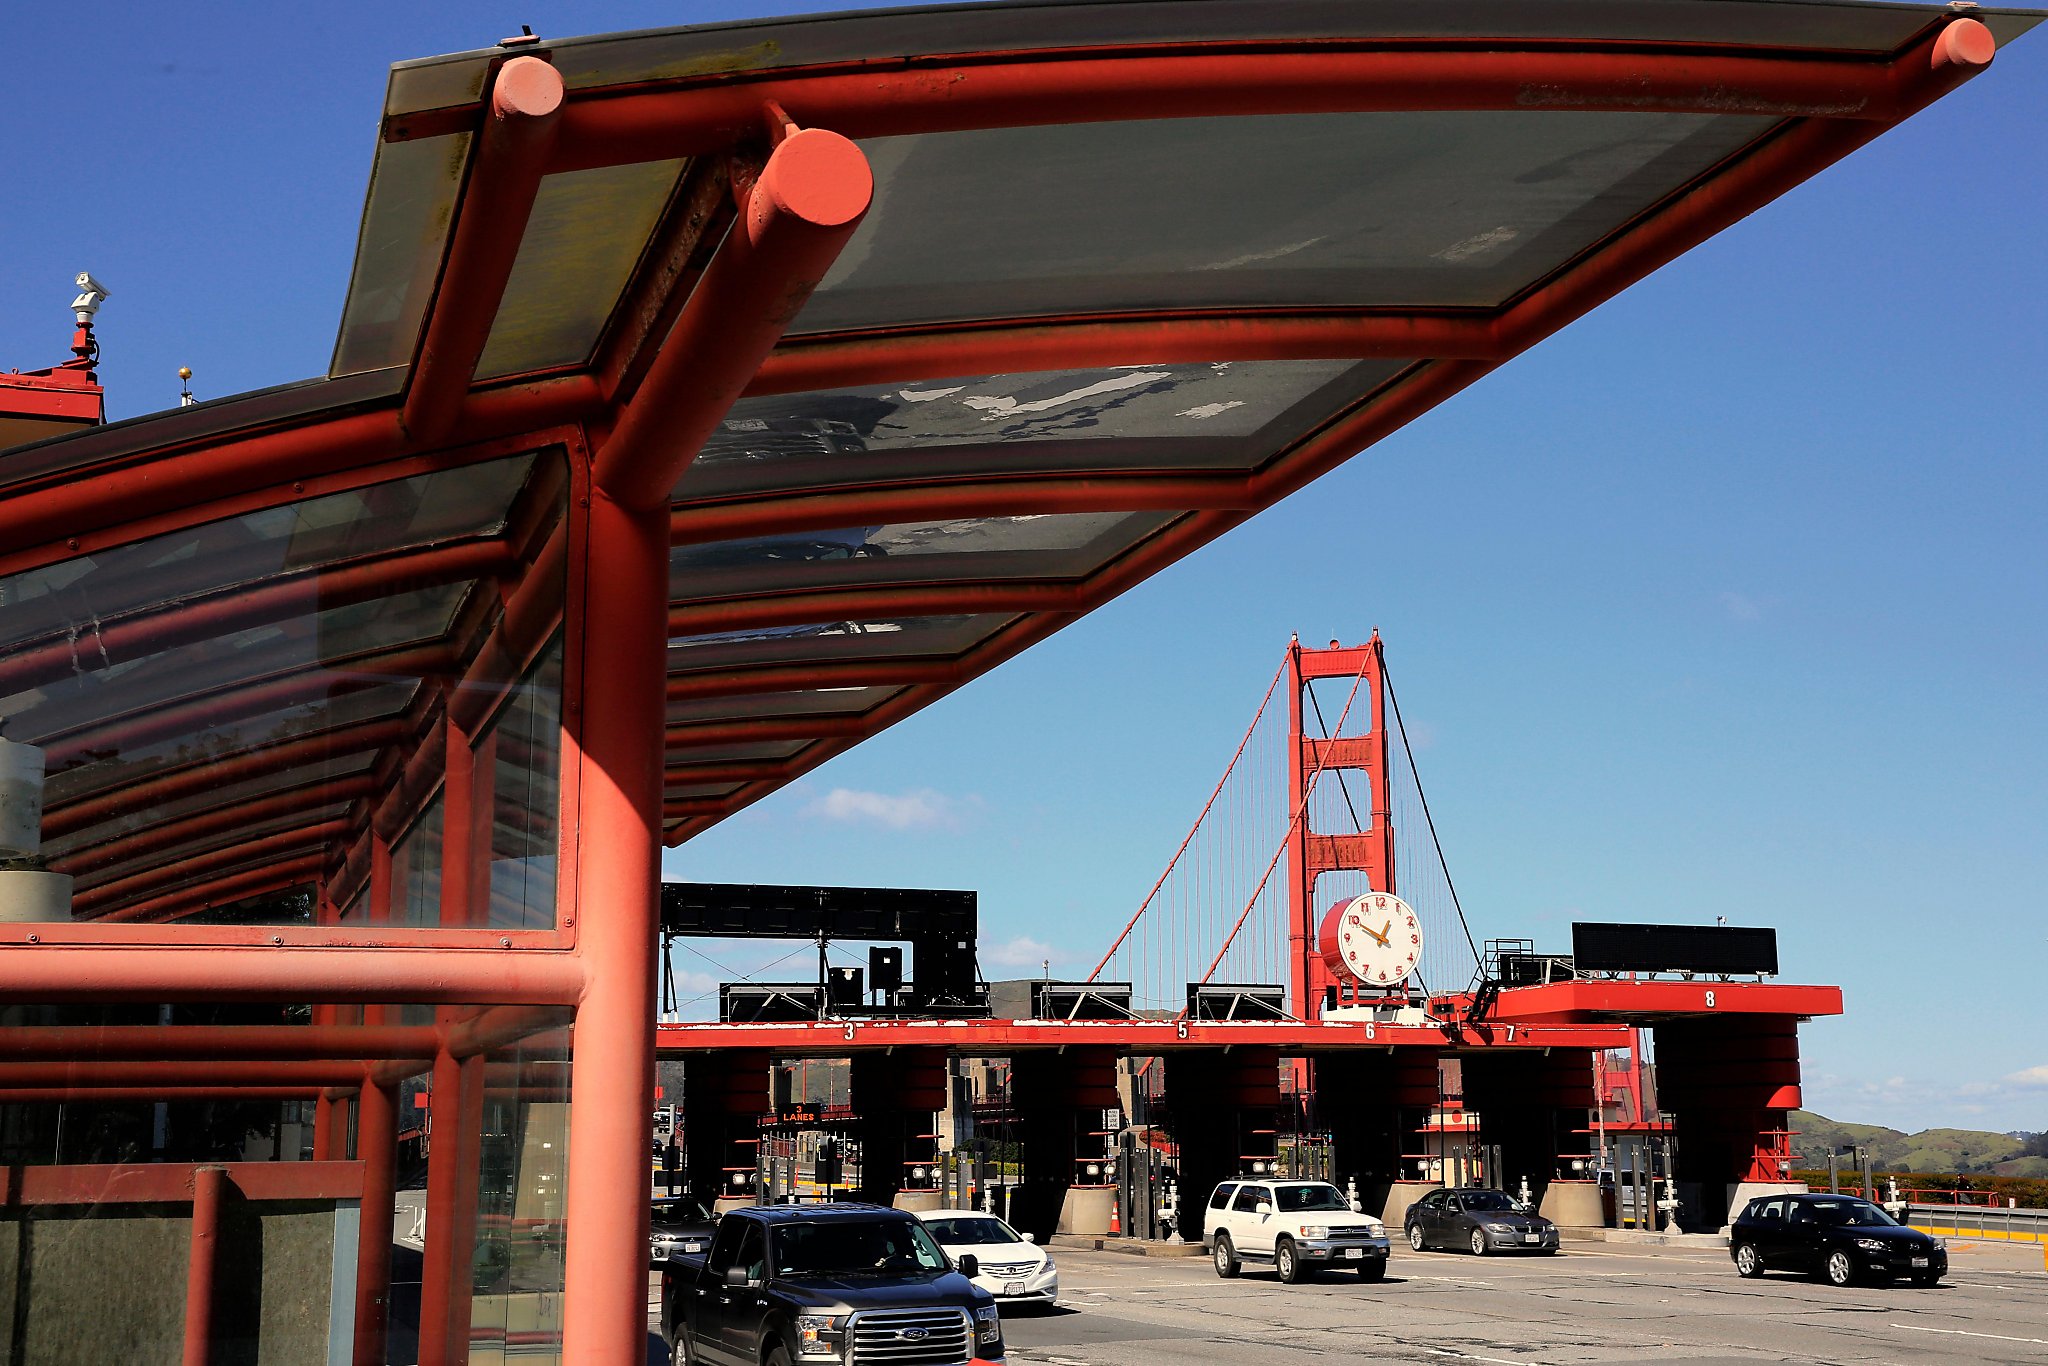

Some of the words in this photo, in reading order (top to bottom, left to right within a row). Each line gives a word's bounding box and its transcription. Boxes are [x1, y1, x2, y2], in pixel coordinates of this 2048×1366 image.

[1375, 897, 1386, 907] 12
[1361, 903, 1369, 913] 11
[1348, 915, 1360, 925] 10
[1406, 916, 1414, 927] 2
[1344, 933, 1351, 942] 9
[1410, 934, 1418, 944] 3
[1349, 951, 1356, 961] 8
[1407, 952, 1414, 962] 4
[1362, 964, 1370, 975] 7
[1395, 966, 1403, 975] 5
[1379, 971, 1386, 980] 6
[1705, 990, 1715, 1007] 8
[844, 1022, 854, 1040] 3
[1178, 1021, 1188, 1038] 5
[1365, 1022, 1375, 1039] 6
[1506, 1025, 1515, 1041] 7
[796, 1105, 802, 1113] 3
[783, 1113, 815, 1121] LANES
